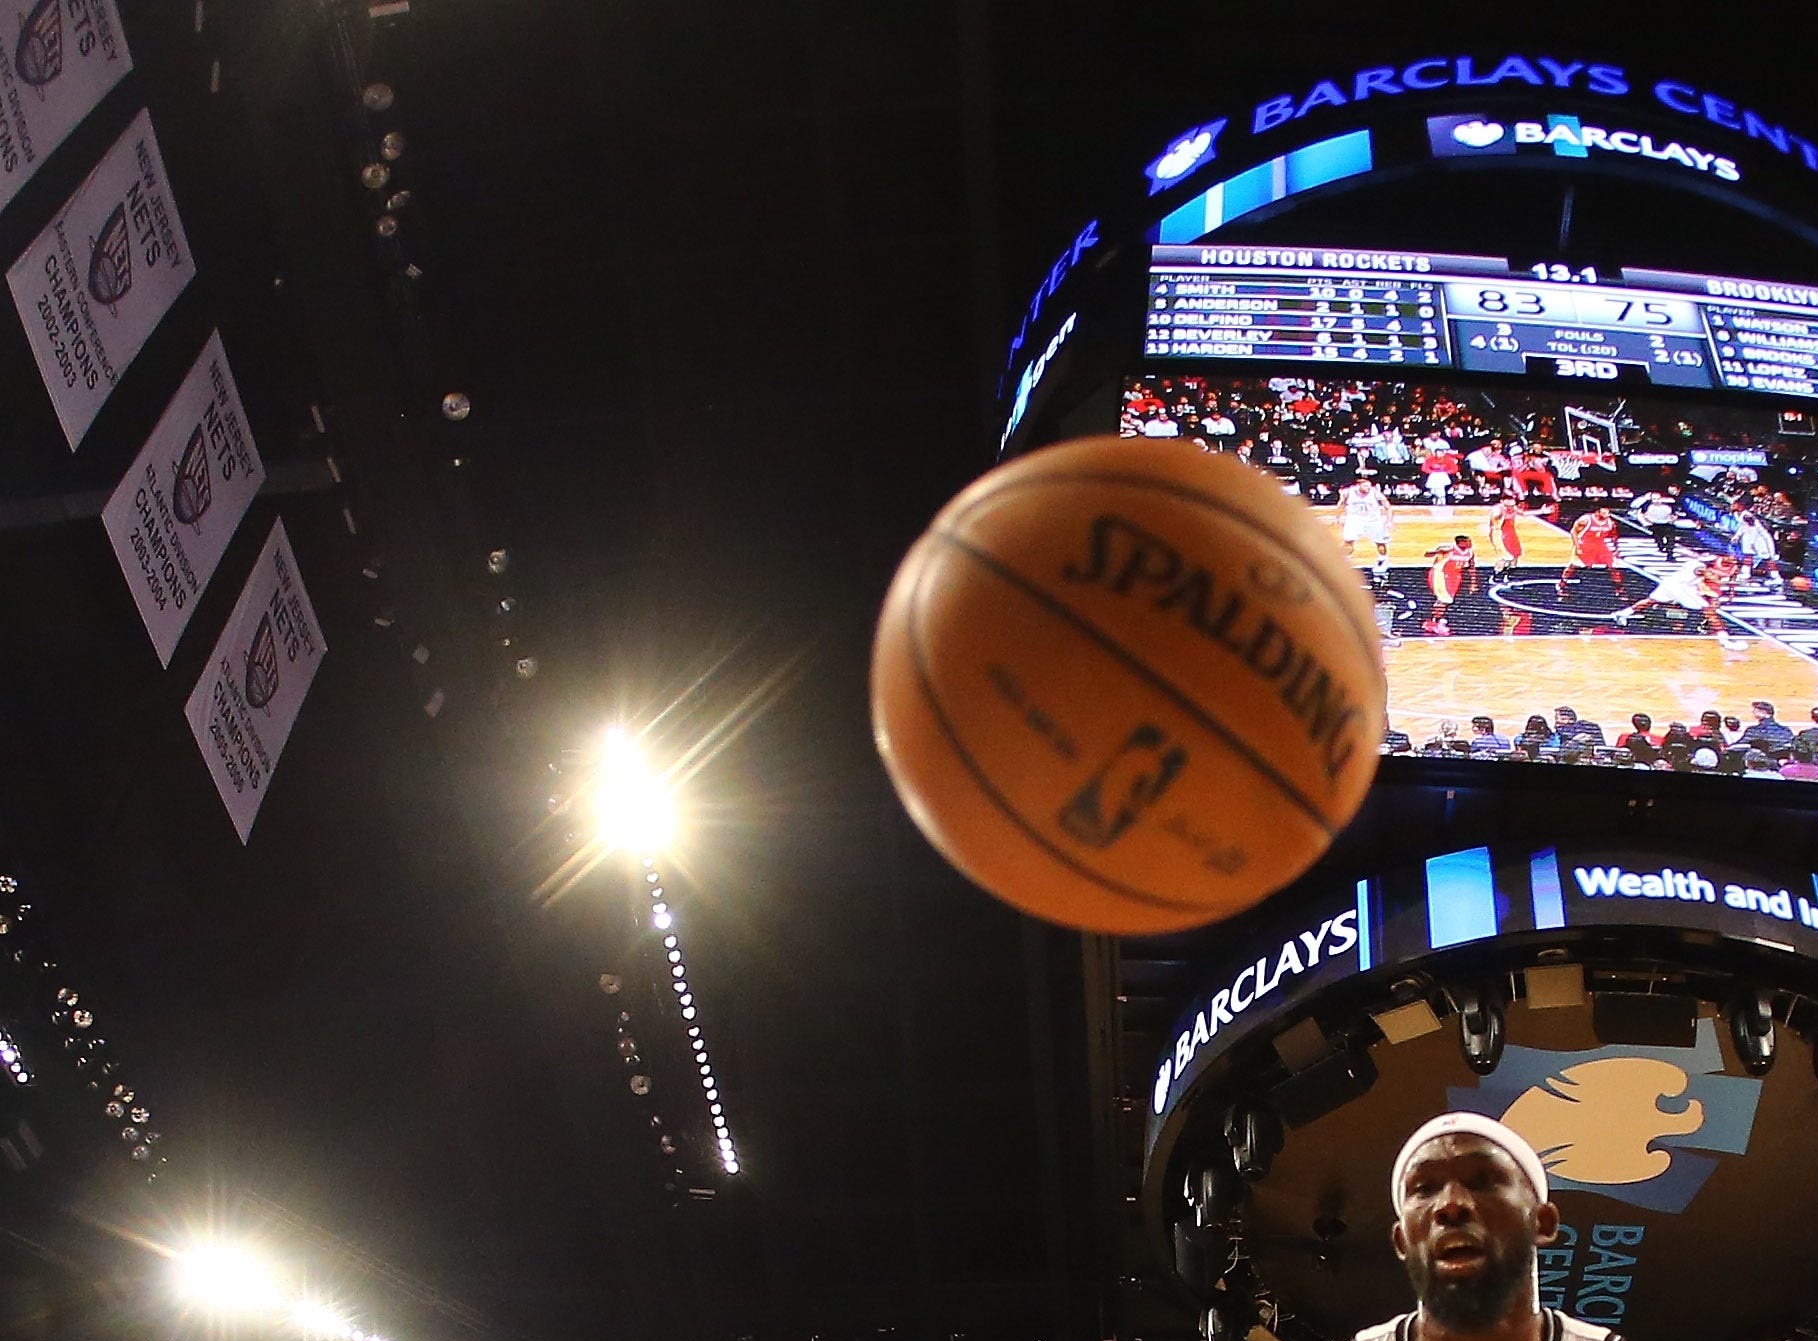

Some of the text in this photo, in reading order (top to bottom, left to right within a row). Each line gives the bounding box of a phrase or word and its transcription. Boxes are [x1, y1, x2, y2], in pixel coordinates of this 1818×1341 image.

[1253, 56, 1629, 134] BARCLAYS
[1515, 121, 1740, 184] BARCLAYS
[126, 179, 161, 268] NETS
[152, 194, 180, 269] JERSEY
[1201, 249, 1431, 273] HOUSTON ROCKETS
[1531, 262, 1598, 284] 13.1
[1160, 274, 1210, 283] PLAYER
[1155, 284, 1432, 303] 4 SMITH 10 0 4 2
[1479, 290, 1545, 315] 83
[1174, 298, 1434, 319] ANDERSON 2 1 1 0
[1605, 298, 1672, 325] 75
[45, 256, 98, 390] CHAMPIONS
[1149, 314, 1171, 326] 10
[1174, 314, 1253, 327] DELFINO
[1311, 317, 1337, 330] 17
[1387, 319, 1402, 331] 4
[1422, 321, 1436, 334] 1
[1497, 323, 1512, 336] 3
[1555, 329, 1605, 342] FOULS
[1732, 316, 1809, 335] WATSON
[37, 294, 77, 389] 2002-2003
[77, 290, 120, 385] CONFERENCE
[1148, 329, 1170, 340] 12
[1172, 329, 1273, 342] BEVERLEY
[1353, 334, 1366, 346] 1
[1388, 335, 1402, 347] 1
[1546, 341, 1577, 354] TOL
[1649, 335, 1665, 348] 2
[1172, 344, 1253, 356] HARDEN
[1311, 346, 1338, 359] 15
[1353, 348, 1368, 360] 4
[1389, 349, 1404, 362] 2
[1424, 351, 1439, 364] 1
[1742, 347, 1816, 366] BROOKS
[1556, 358, 1618, 380] 3RD
[1747, 362, 1807, 380] LOPEZ
[1751, 376, 1814, 395] EVANS
[203, 401, 236, 482] NETS
[226, 411, 254, 478] JERSEY
[146, 463, 200, 596] ATLANTIC DIVISION
[135, 487, 186, 610] CHAMPIONS
[130, 527, 167, 611] 2003-2004
[270, 589, 301, 662] NETS
[1064, 514, 1362, 780] SPALDING
[213, 680, 261, 790] CHAMPIONS
[1573, 867, 1717, 903] Wealth
[1724, 884, 1794, 920] and
[1174, 909, 1358, 1080] BARCLAYS
